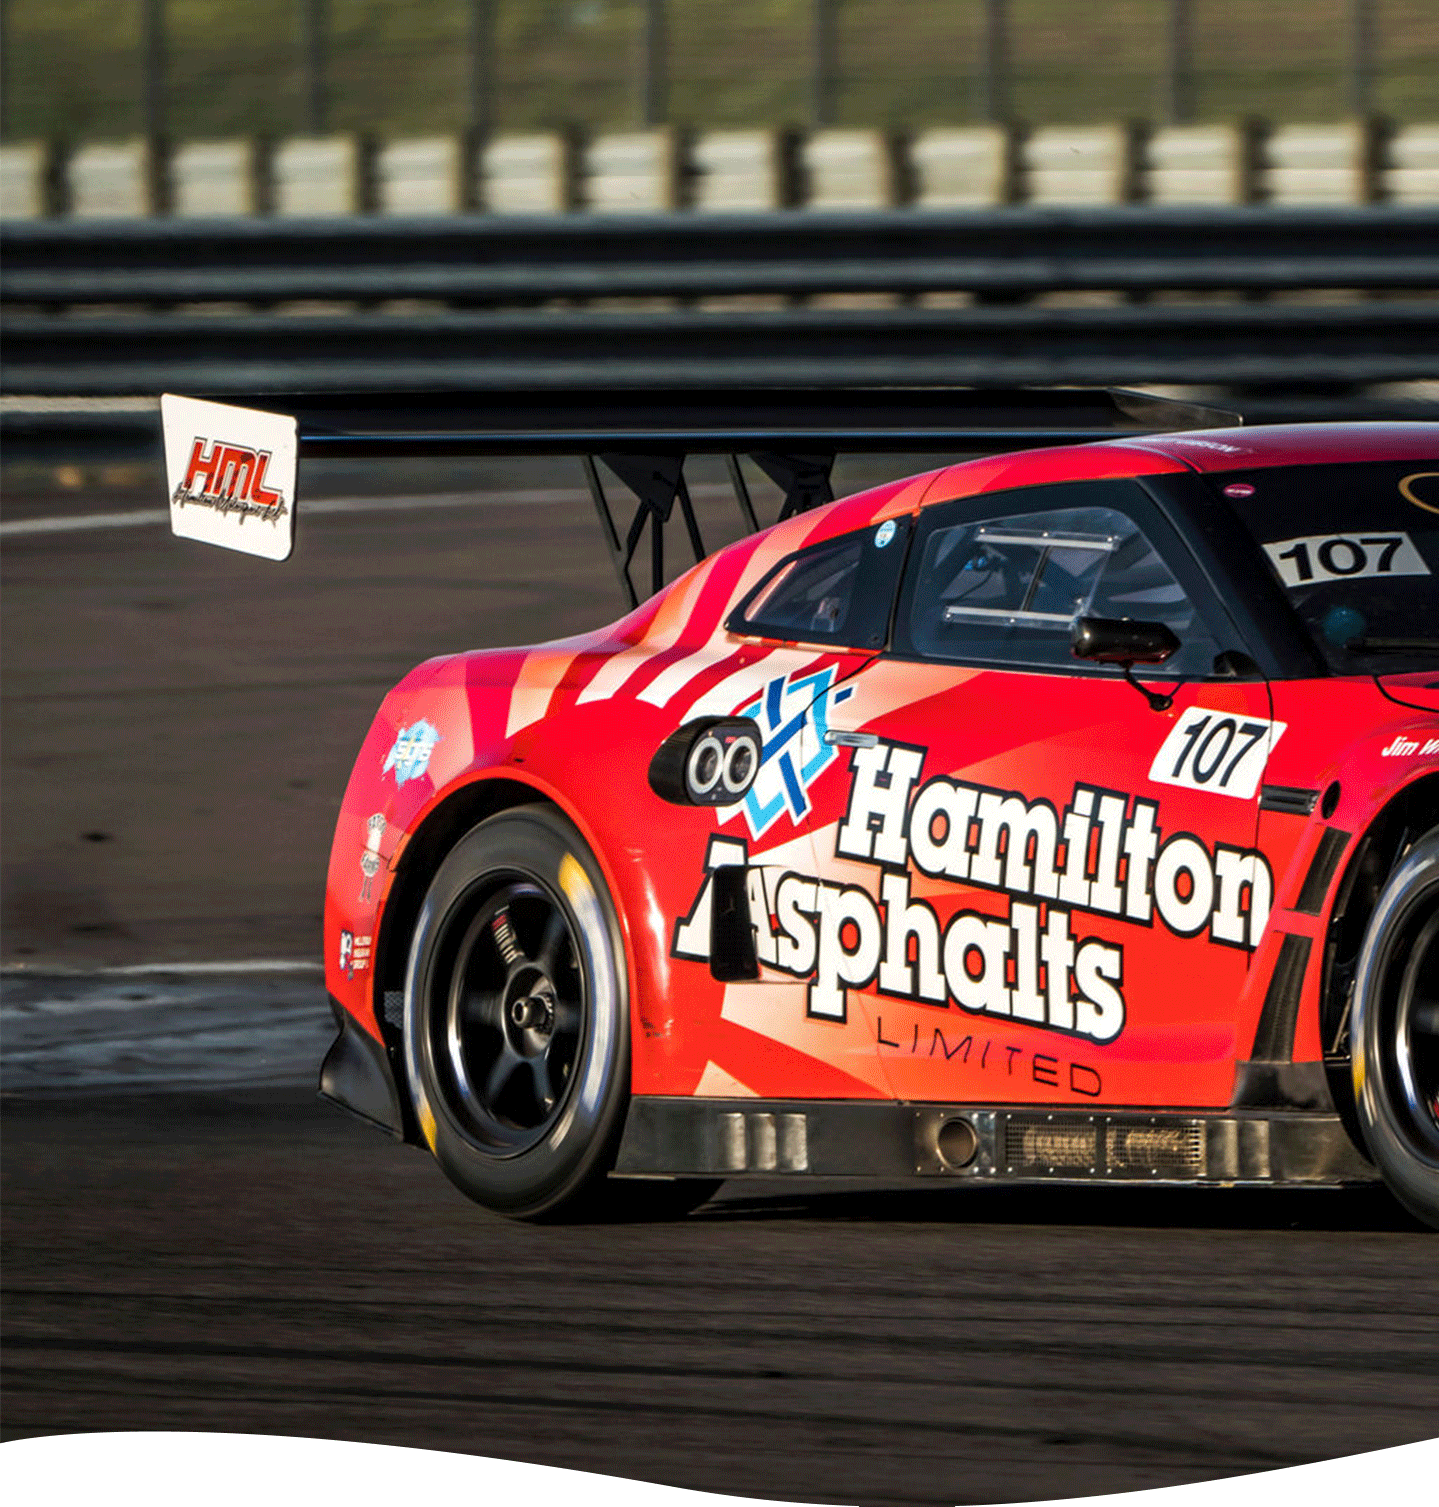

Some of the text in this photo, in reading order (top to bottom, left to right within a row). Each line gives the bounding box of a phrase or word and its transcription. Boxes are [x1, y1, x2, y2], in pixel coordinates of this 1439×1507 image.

[183, 436, 283, 507] HML
[1278, 537, 1404, 581] 107
[1168, 715, 1268, 789] 107
[1381, 735, 1419, 757] Jim
[836, 738, 1275, 952] Hamilton
[670, 832, 1126, 1046] Asphalts
[876, 1016, 1103, 1098] LIMITED
